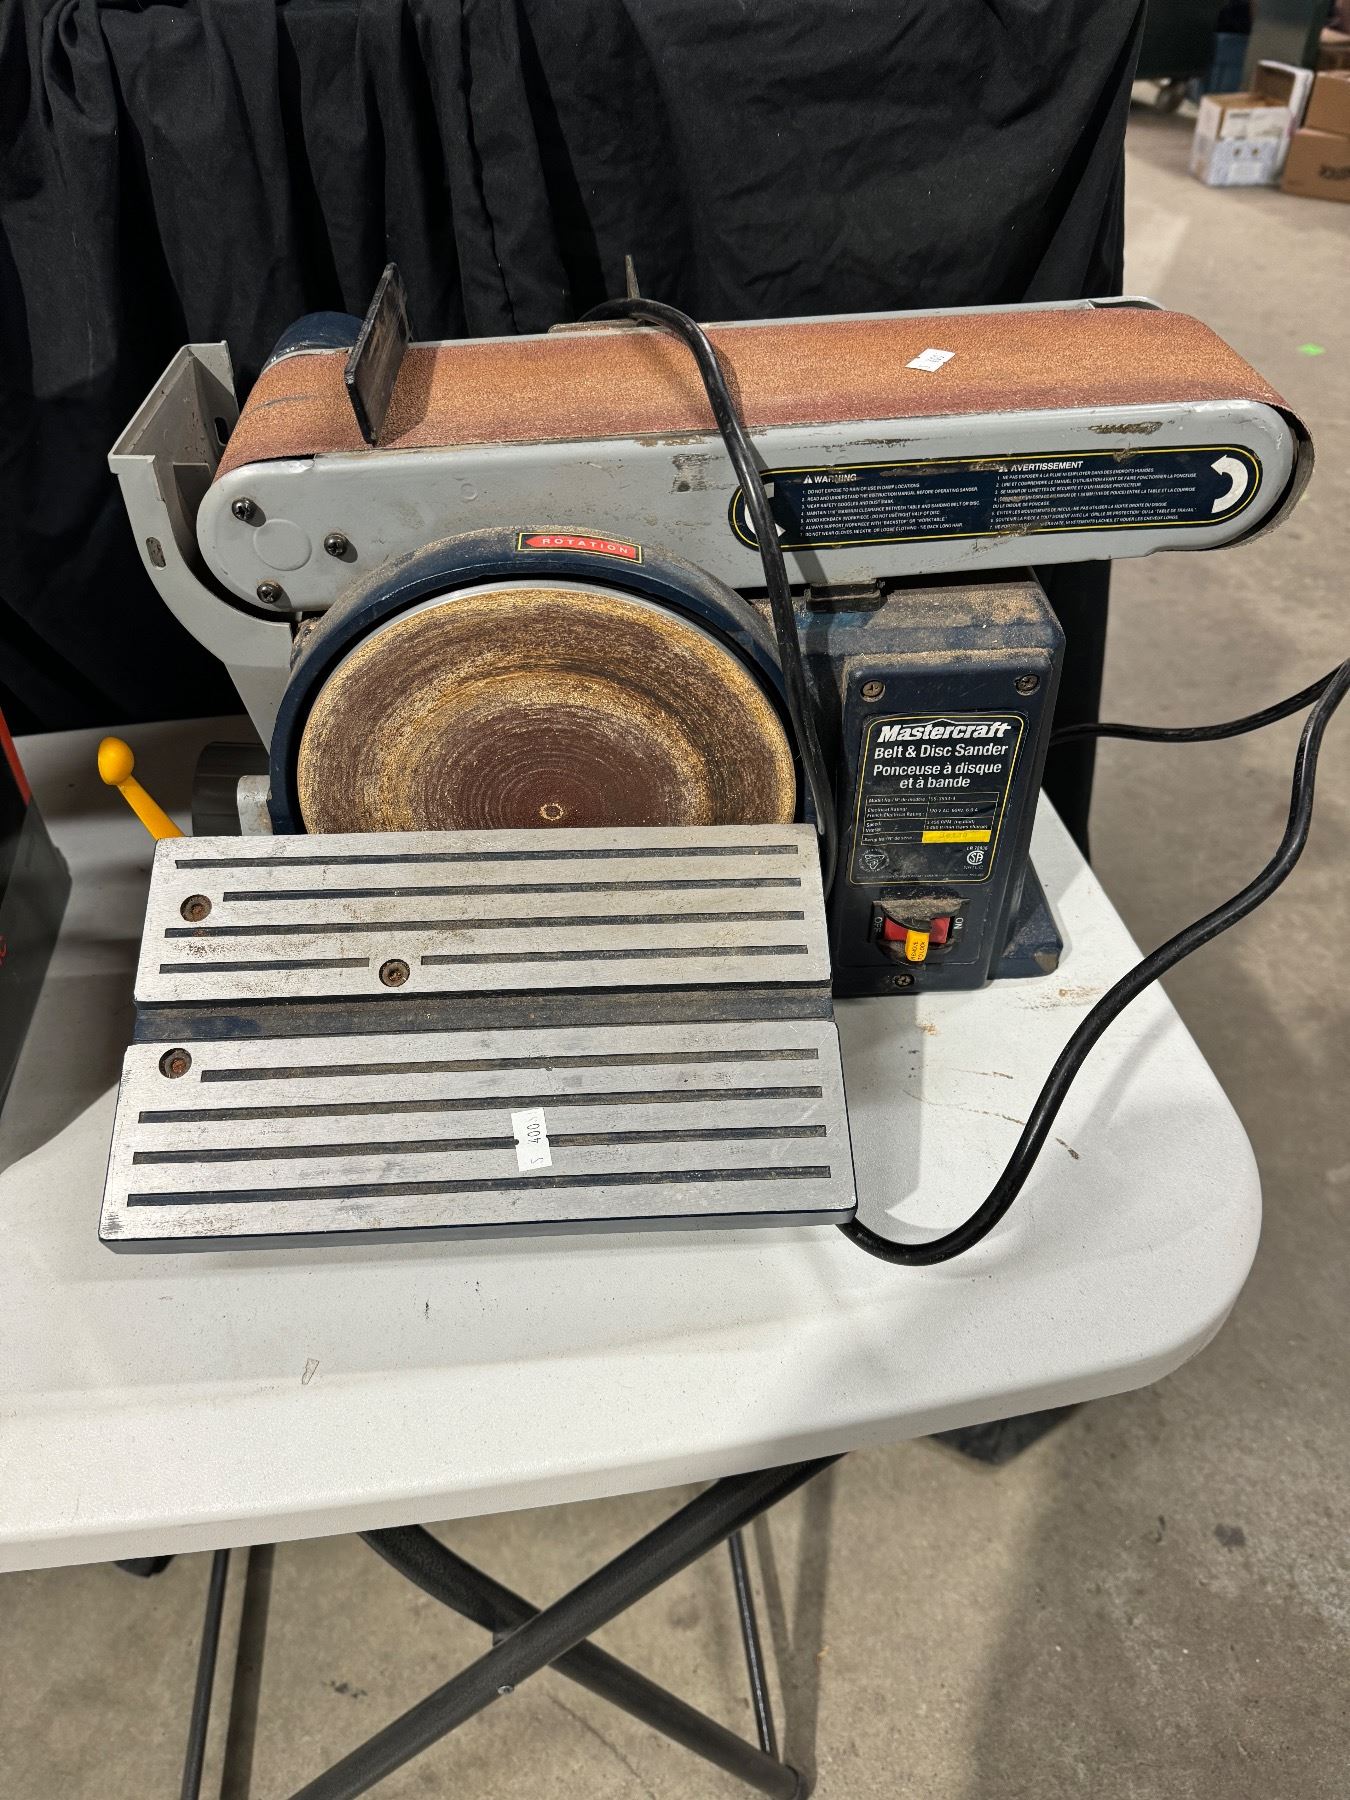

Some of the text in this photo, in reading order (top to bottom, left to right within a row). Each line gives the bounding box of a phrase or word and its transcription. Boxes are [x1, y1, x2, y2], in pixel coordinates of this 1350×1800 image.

[1010, 461, 1083, 472] AVERTISSEMENT
[814, 474, 857, 483] WARNING
[542, 538, 628, 554] ROTATION
[876, 722, 1012, 742] Mastercraft
[874, 742, 1008, 759] Belt & Disc Sander
[873, 762, 1002, 776] Ponceuse à disque
[899, 776, 971, 789] et à bande
[954, 917, 963, 929] ON
